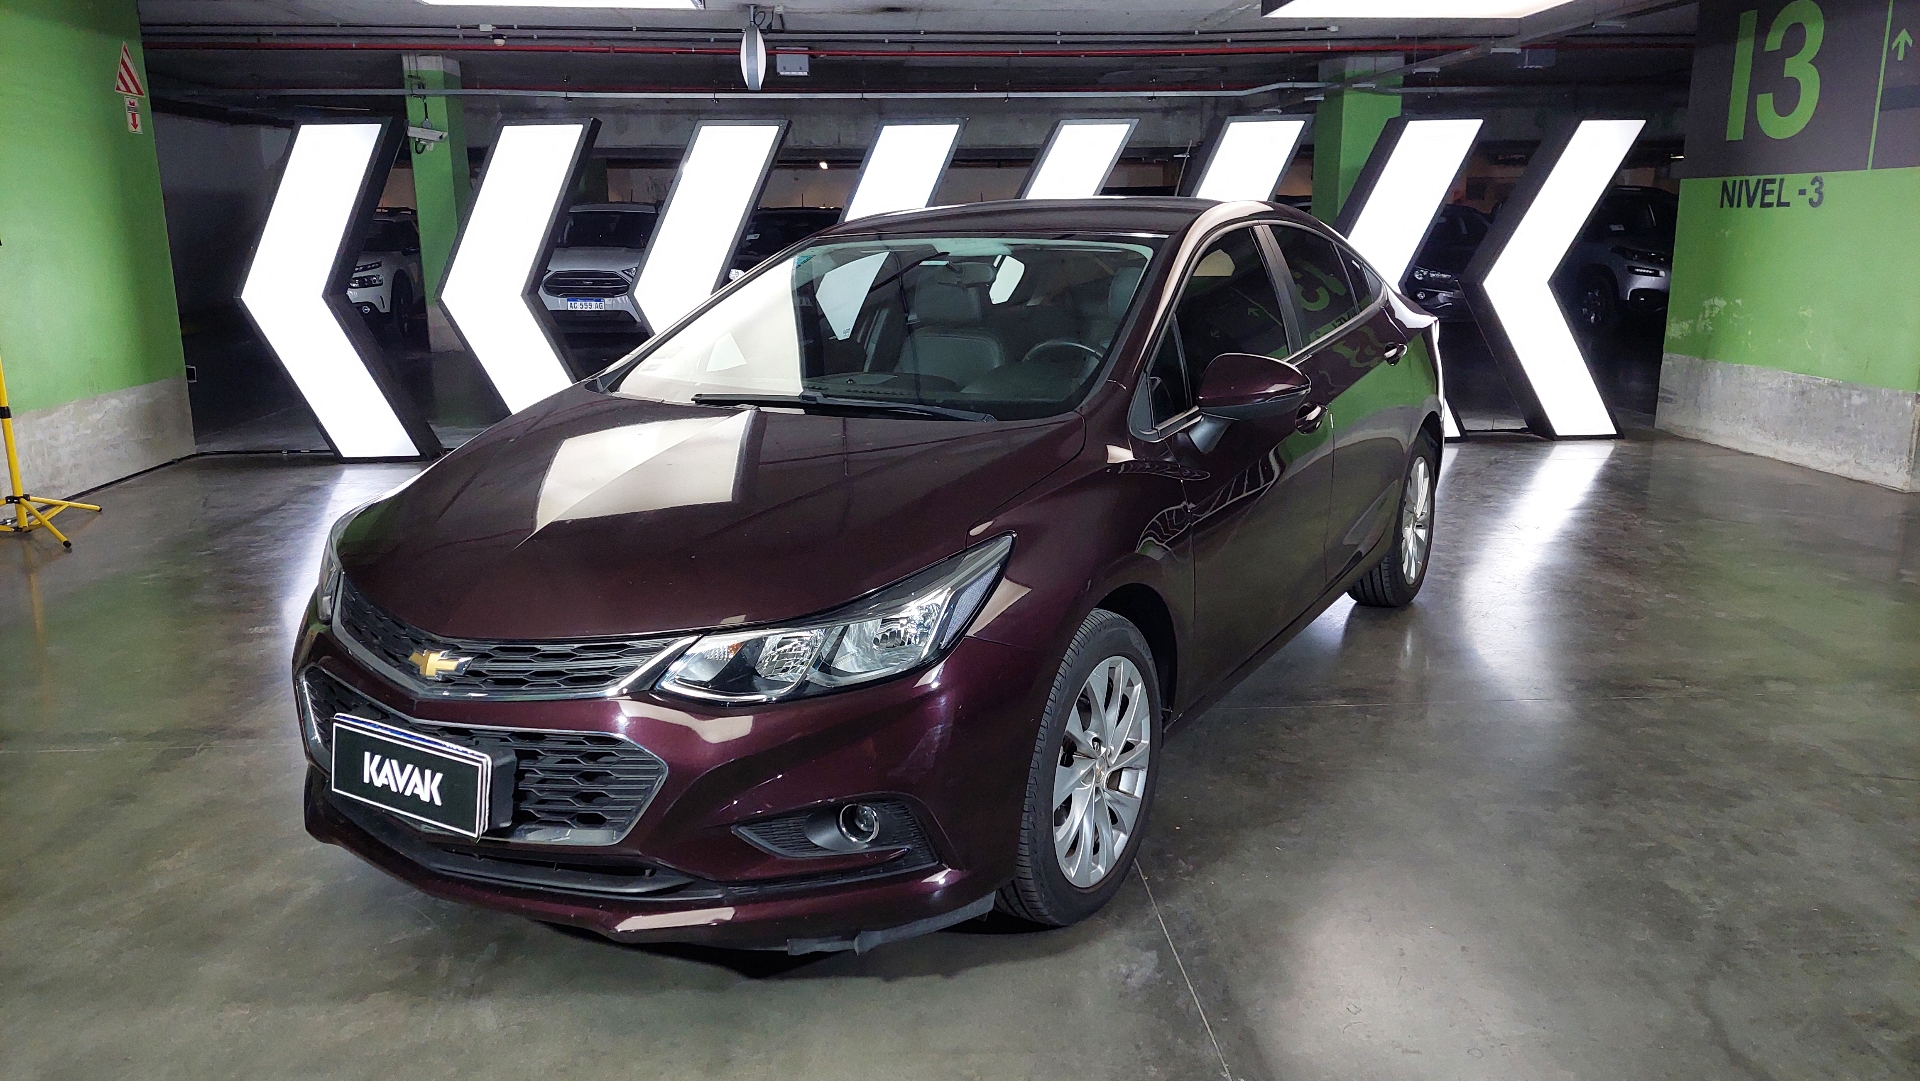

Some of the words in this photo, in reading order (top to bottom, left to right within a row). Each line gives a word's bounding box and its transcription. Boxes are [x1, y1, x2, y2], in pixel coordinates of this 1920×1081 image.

[1726, 0, 1824, 140] 13
[1719, 178, 1791, 209] NIVEL
[1798, 176, 1825, 208] -3
[363, 751, 443, 806] KAVAK
